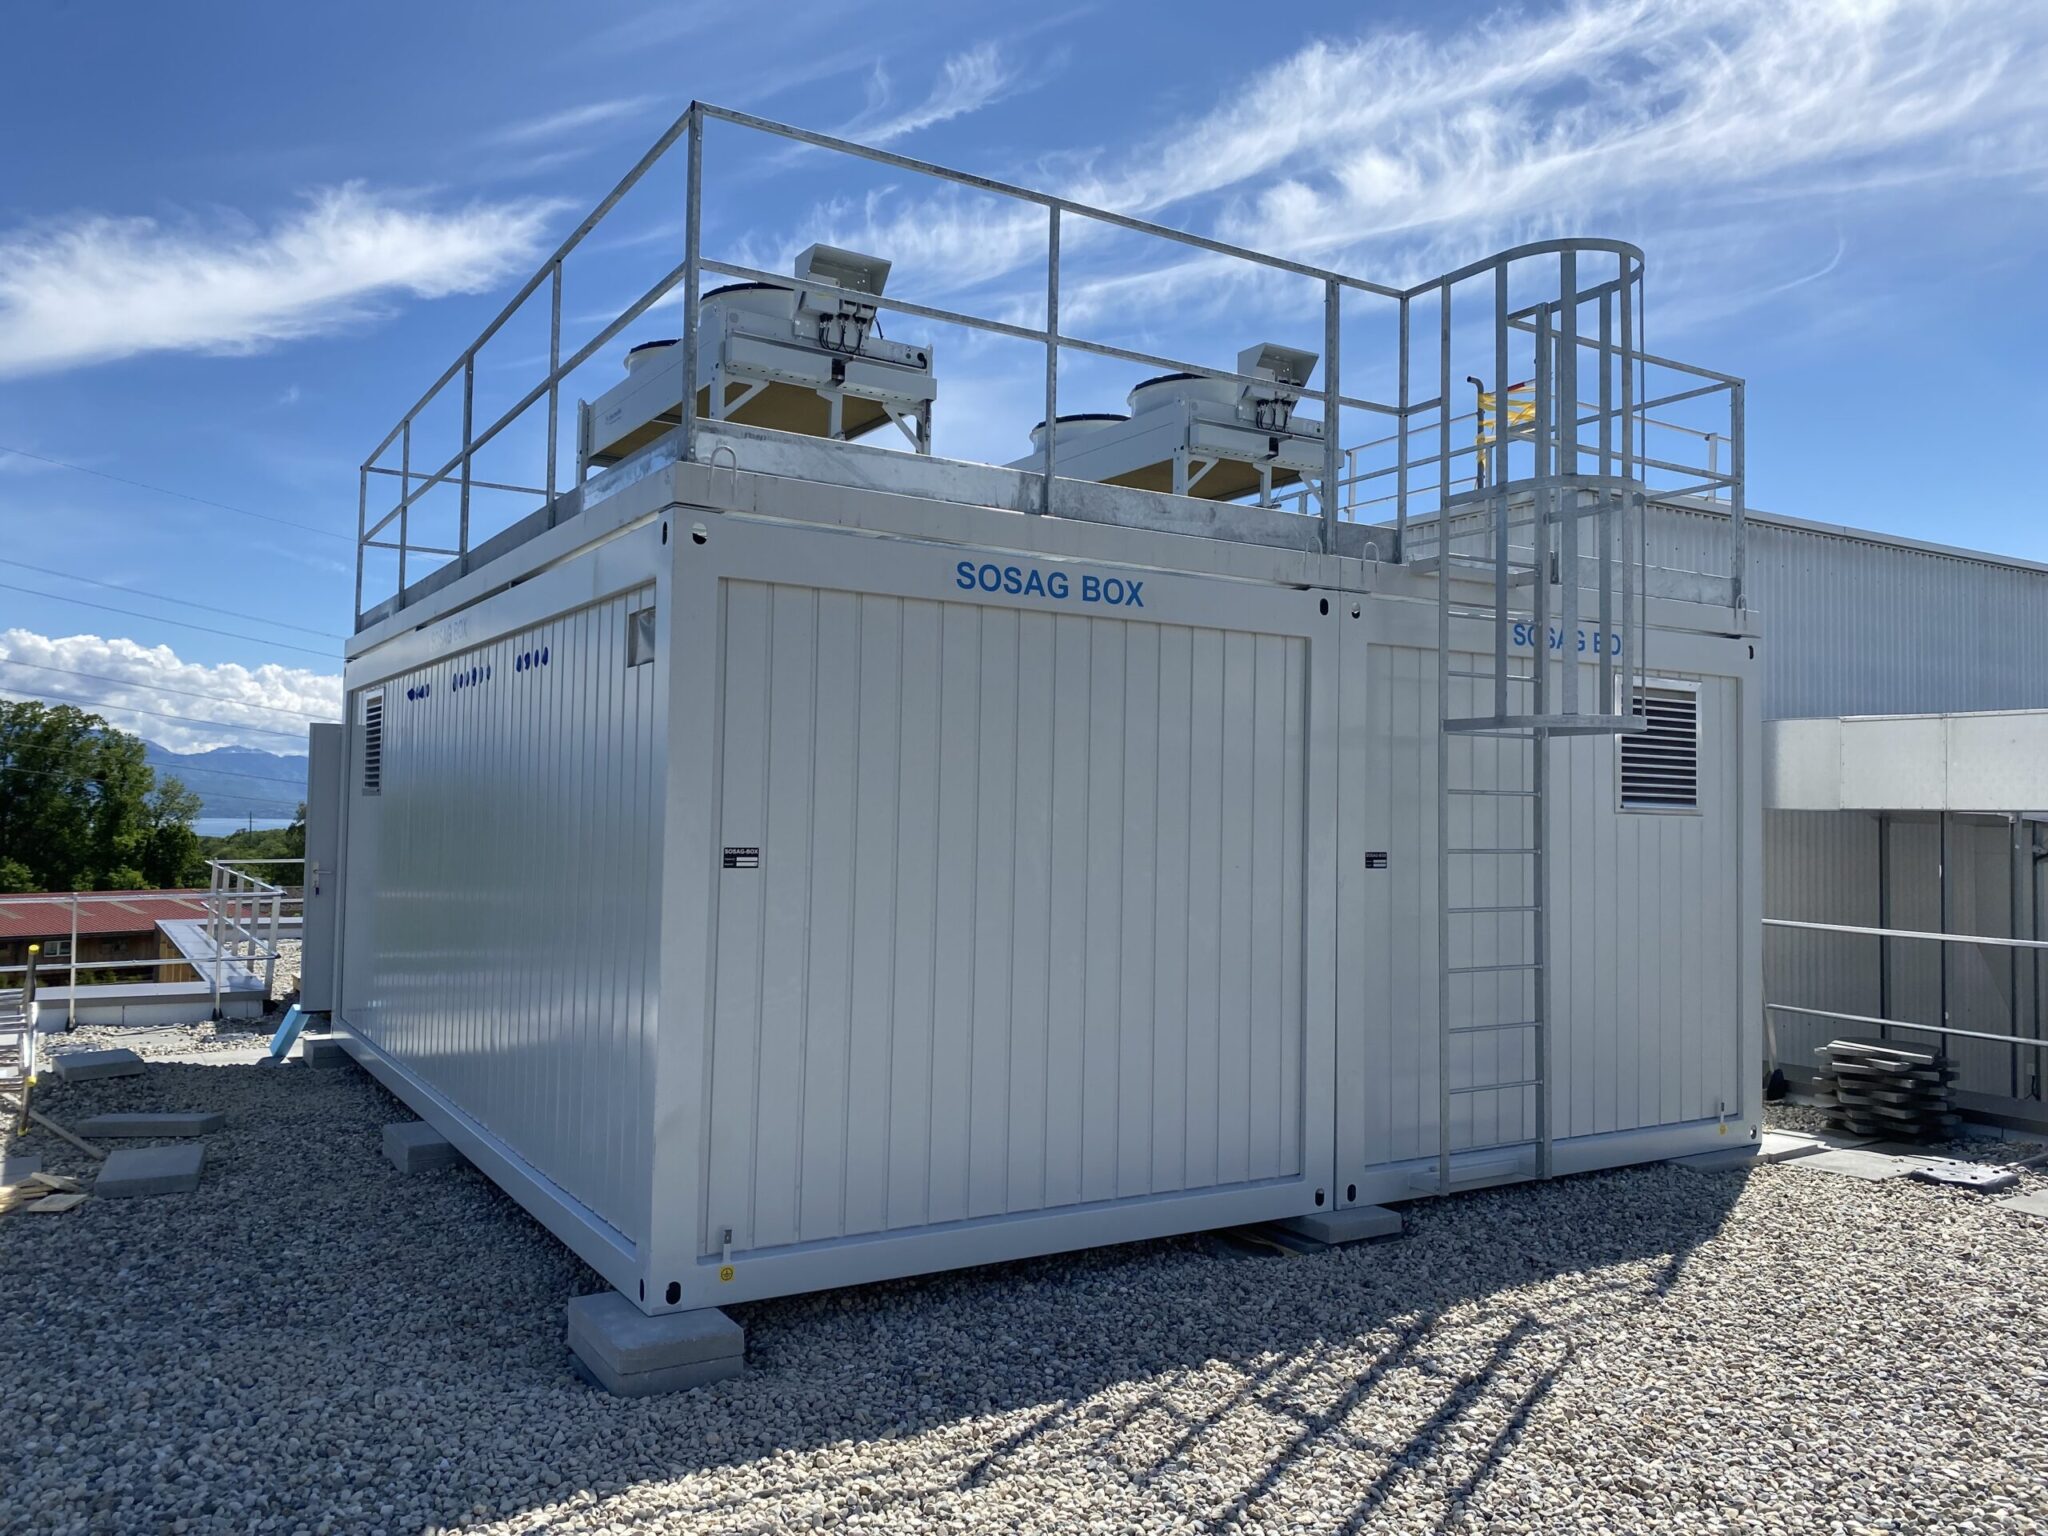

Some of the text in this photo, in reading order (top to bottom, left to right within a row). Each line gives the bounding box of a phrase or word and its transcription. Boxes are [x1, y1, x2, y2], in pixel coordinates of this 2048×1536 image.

[956, 561, 1145, 607] SOSAG BOX
[1593, 632, 1624, 656] BO
